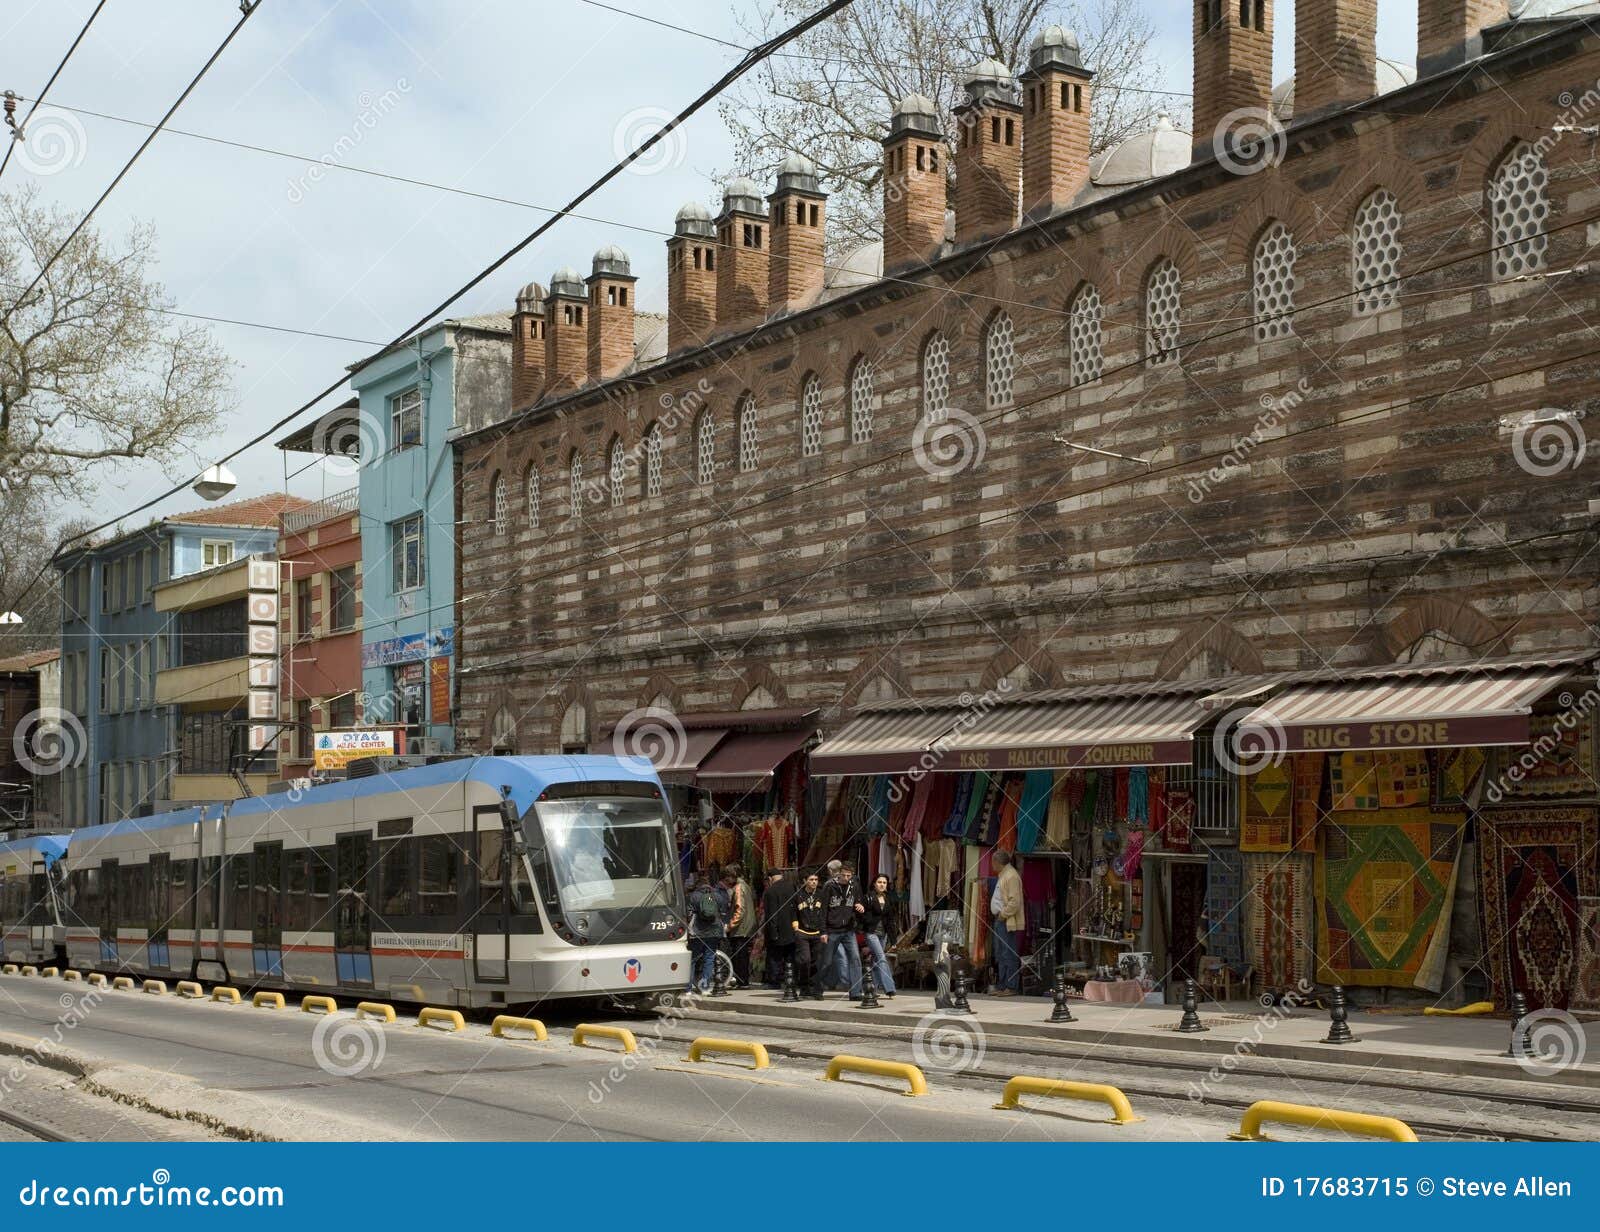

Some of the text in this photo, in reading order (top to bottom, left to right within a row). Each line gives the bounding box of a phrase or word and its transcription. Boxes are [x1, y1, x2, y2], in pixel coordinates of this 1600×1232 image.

[252, 565, 275, 748] HOSTEL
[1303, 722, 1449, 748] RUG STORE
[960, 752, 990, 768] KARS
[650, 921, 667, 930] 729
